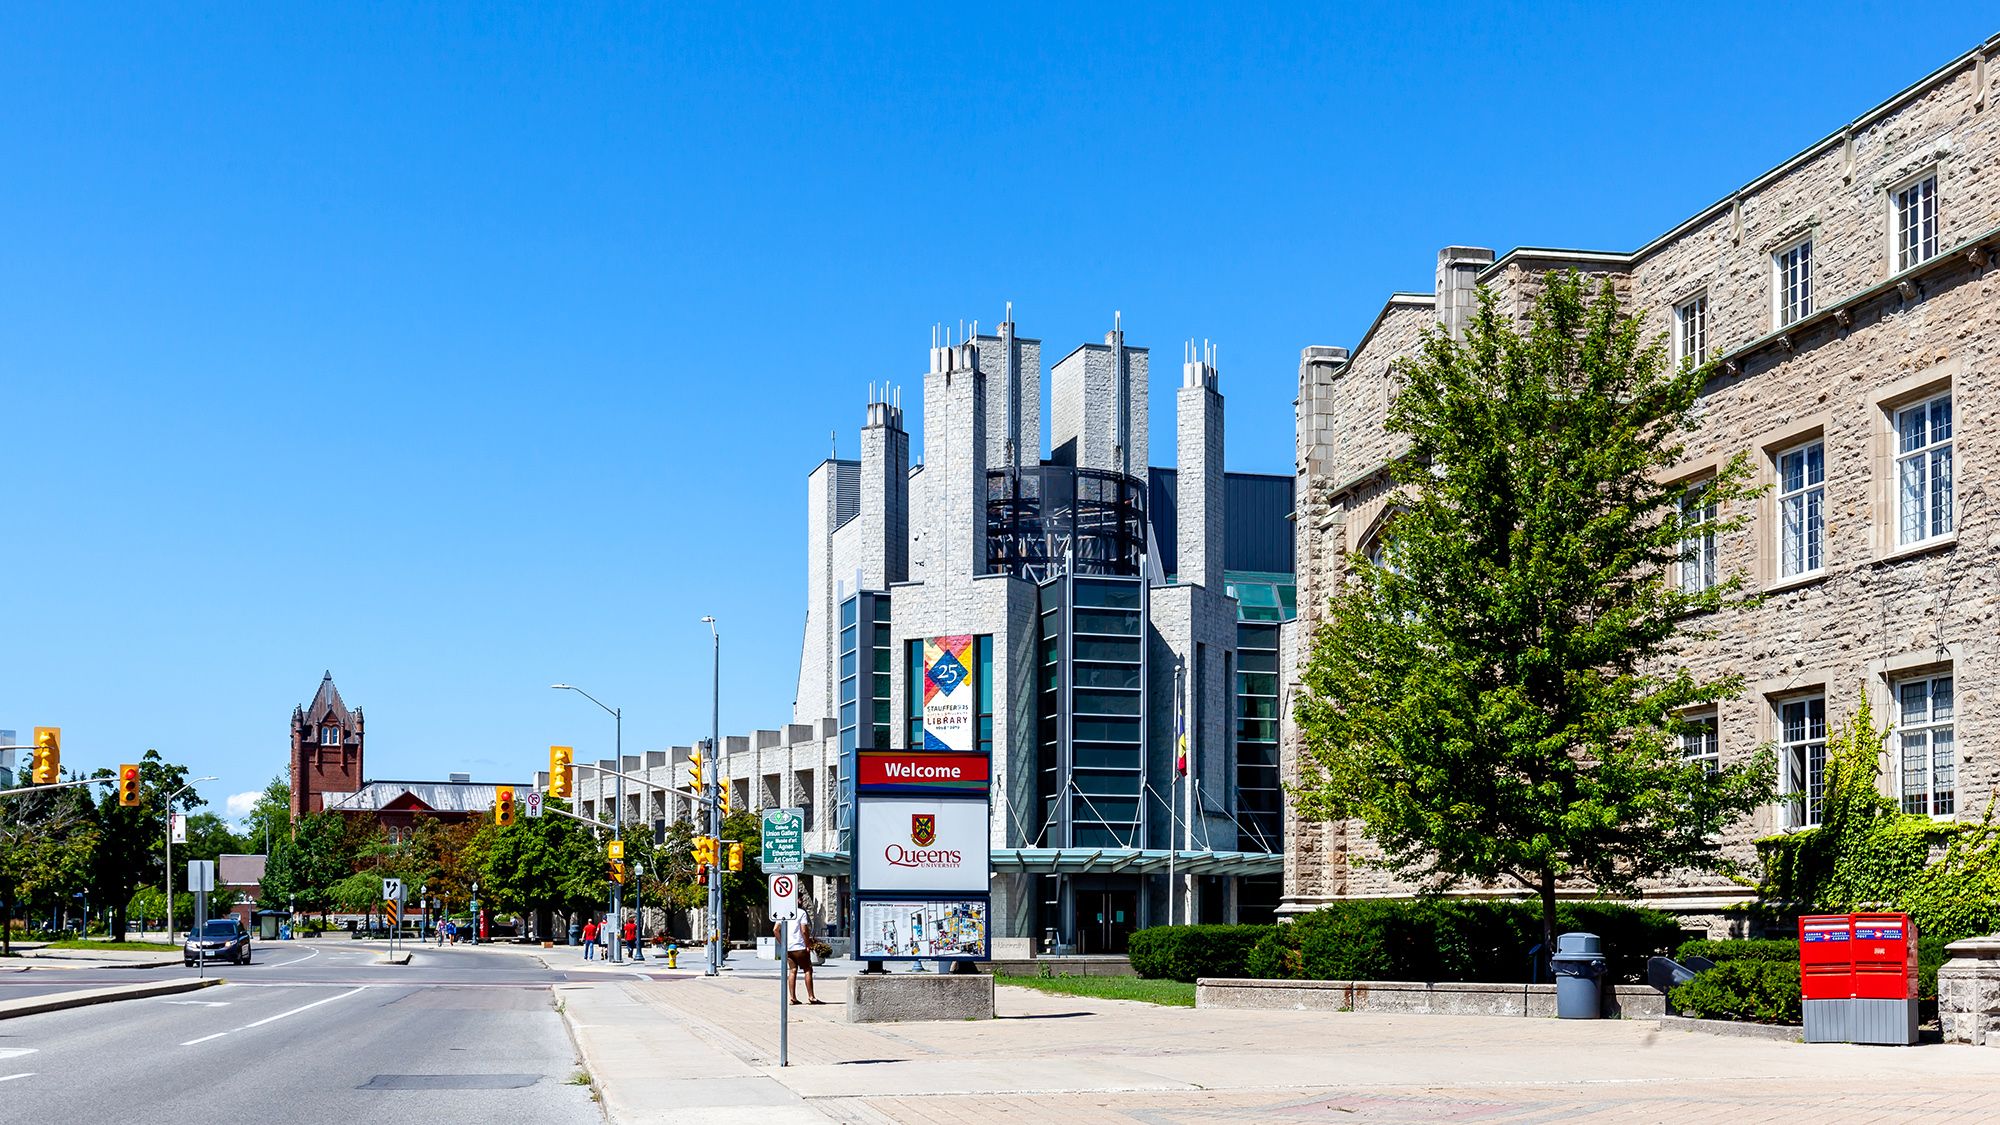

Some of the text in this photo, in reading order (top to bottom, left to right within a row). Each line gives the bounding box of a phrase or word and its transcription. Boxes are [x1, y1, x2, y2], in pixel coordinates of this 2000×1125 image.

[937, 664, 958, 684] 25
[927, 716, 968, 725] LIBRARY
[884, 762, 961, 778] Welcome
[885, 844, 961, 867] Queen's
